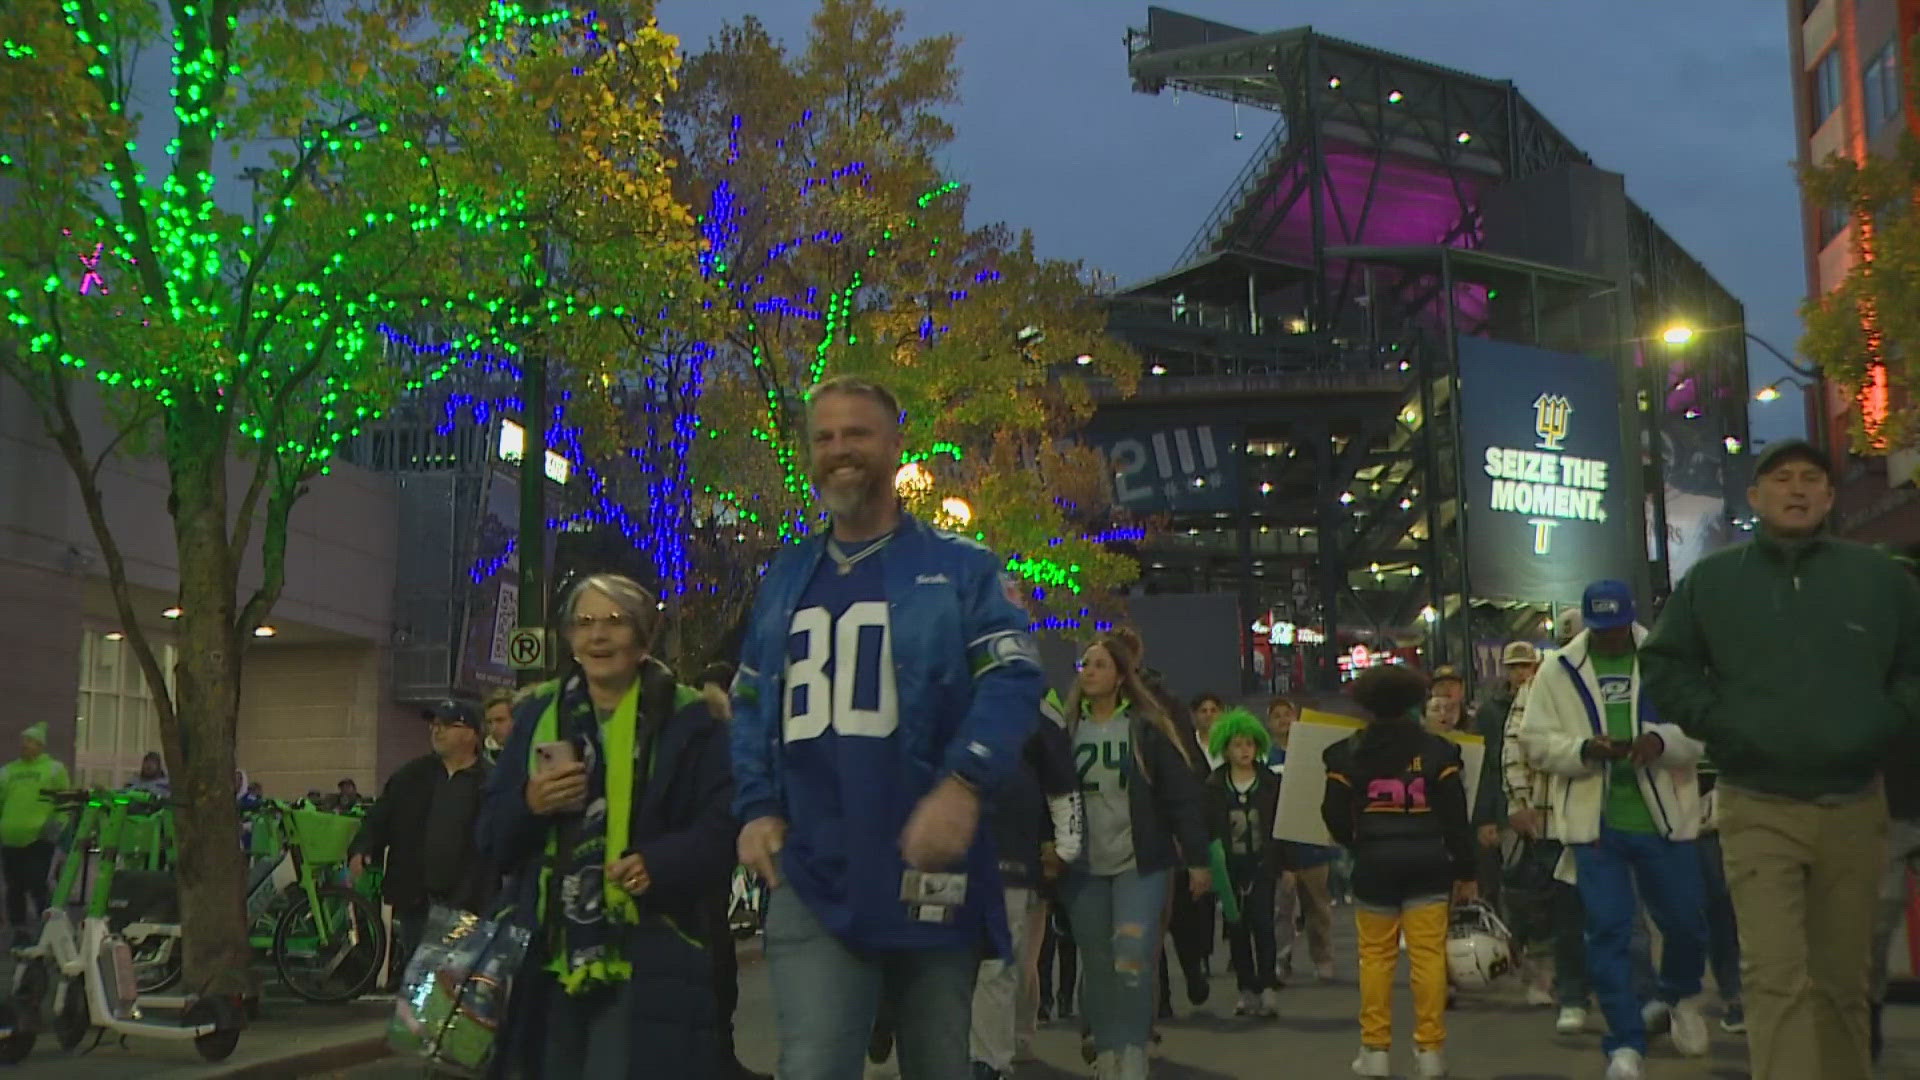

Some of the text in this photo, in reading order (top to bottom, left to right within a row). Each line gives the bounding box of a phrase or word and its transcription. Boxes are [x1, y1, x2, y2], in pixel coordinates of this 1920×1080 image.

[1484, 447, 1608, 490] SEIZE THE
[783, 601, 899, 744] 80
[1075, 741, 1128, 790] 24
